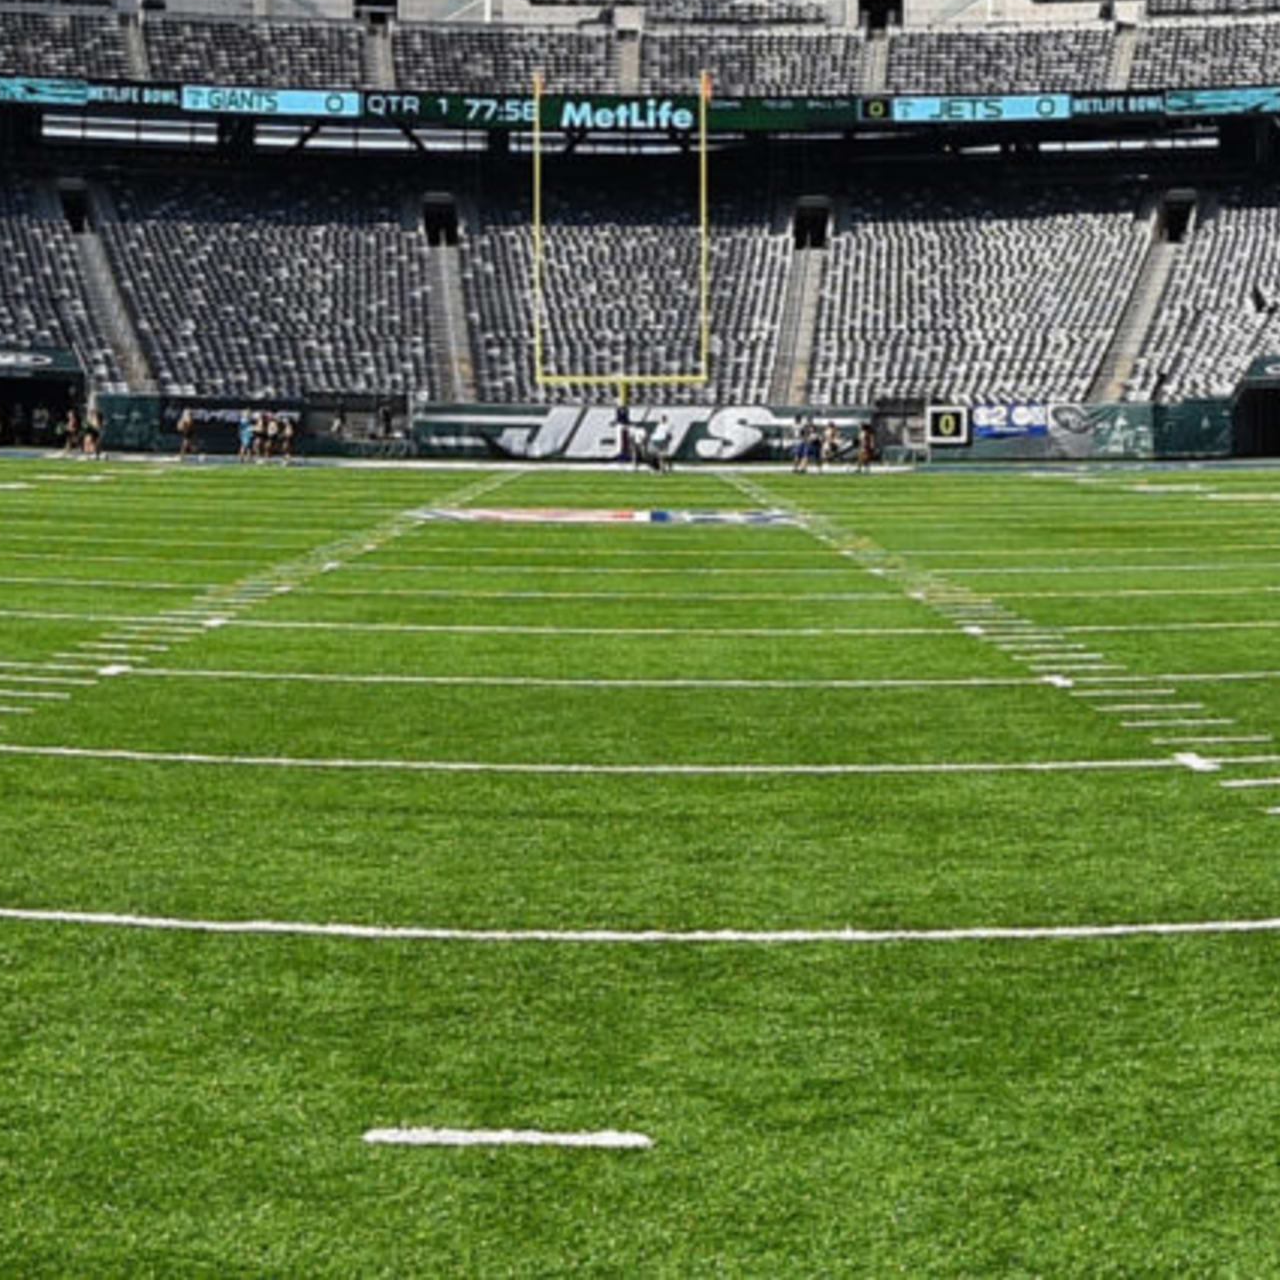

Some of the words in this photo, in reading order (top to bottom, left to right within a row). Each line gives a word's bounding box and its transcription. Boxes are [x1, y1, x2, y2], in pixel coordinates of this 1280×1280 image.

[207, 91, 279, 112] GIANTS
[368, 95, 420, 115] QTR
[929, 98, 1004, 119] JETS
[561, 99, 694, 129] MetLife
[500, 406, 779, 459] JETS
[938, 414, 956, 435] 0
